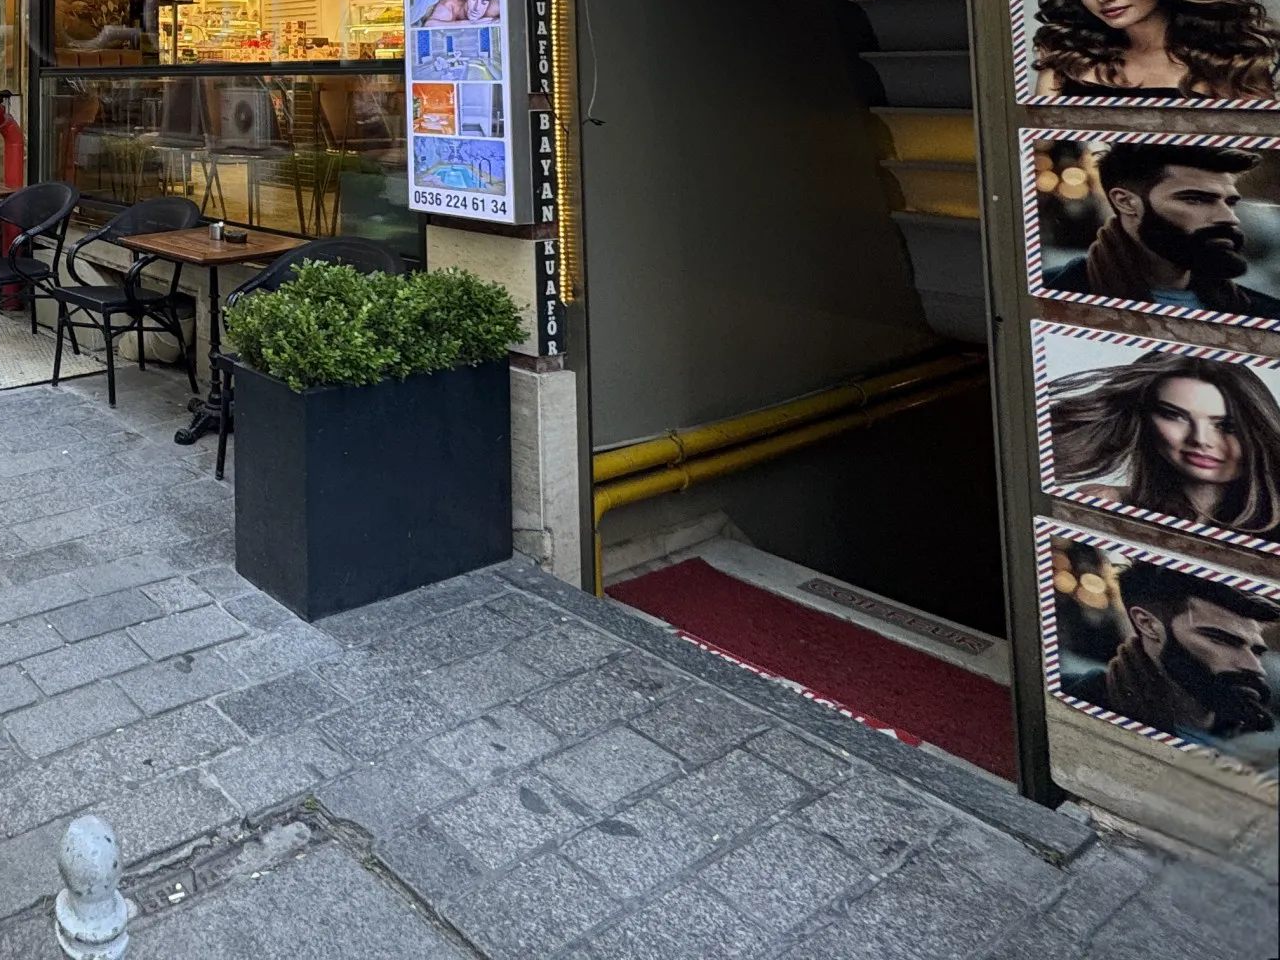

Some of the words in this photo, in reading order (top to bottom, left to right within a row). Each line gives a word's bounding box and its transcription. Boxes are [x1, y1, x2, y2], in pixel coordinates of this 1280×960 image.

[414, 191, 443, 208] 0536
[445, 194, 469, 211] 224
[471, 196, 487, 214] 61
[489, 199, 508, 216] 34
[538, 113, 555, 223] BAYAN
[543, 240, 559, 356] KUAFÖR
